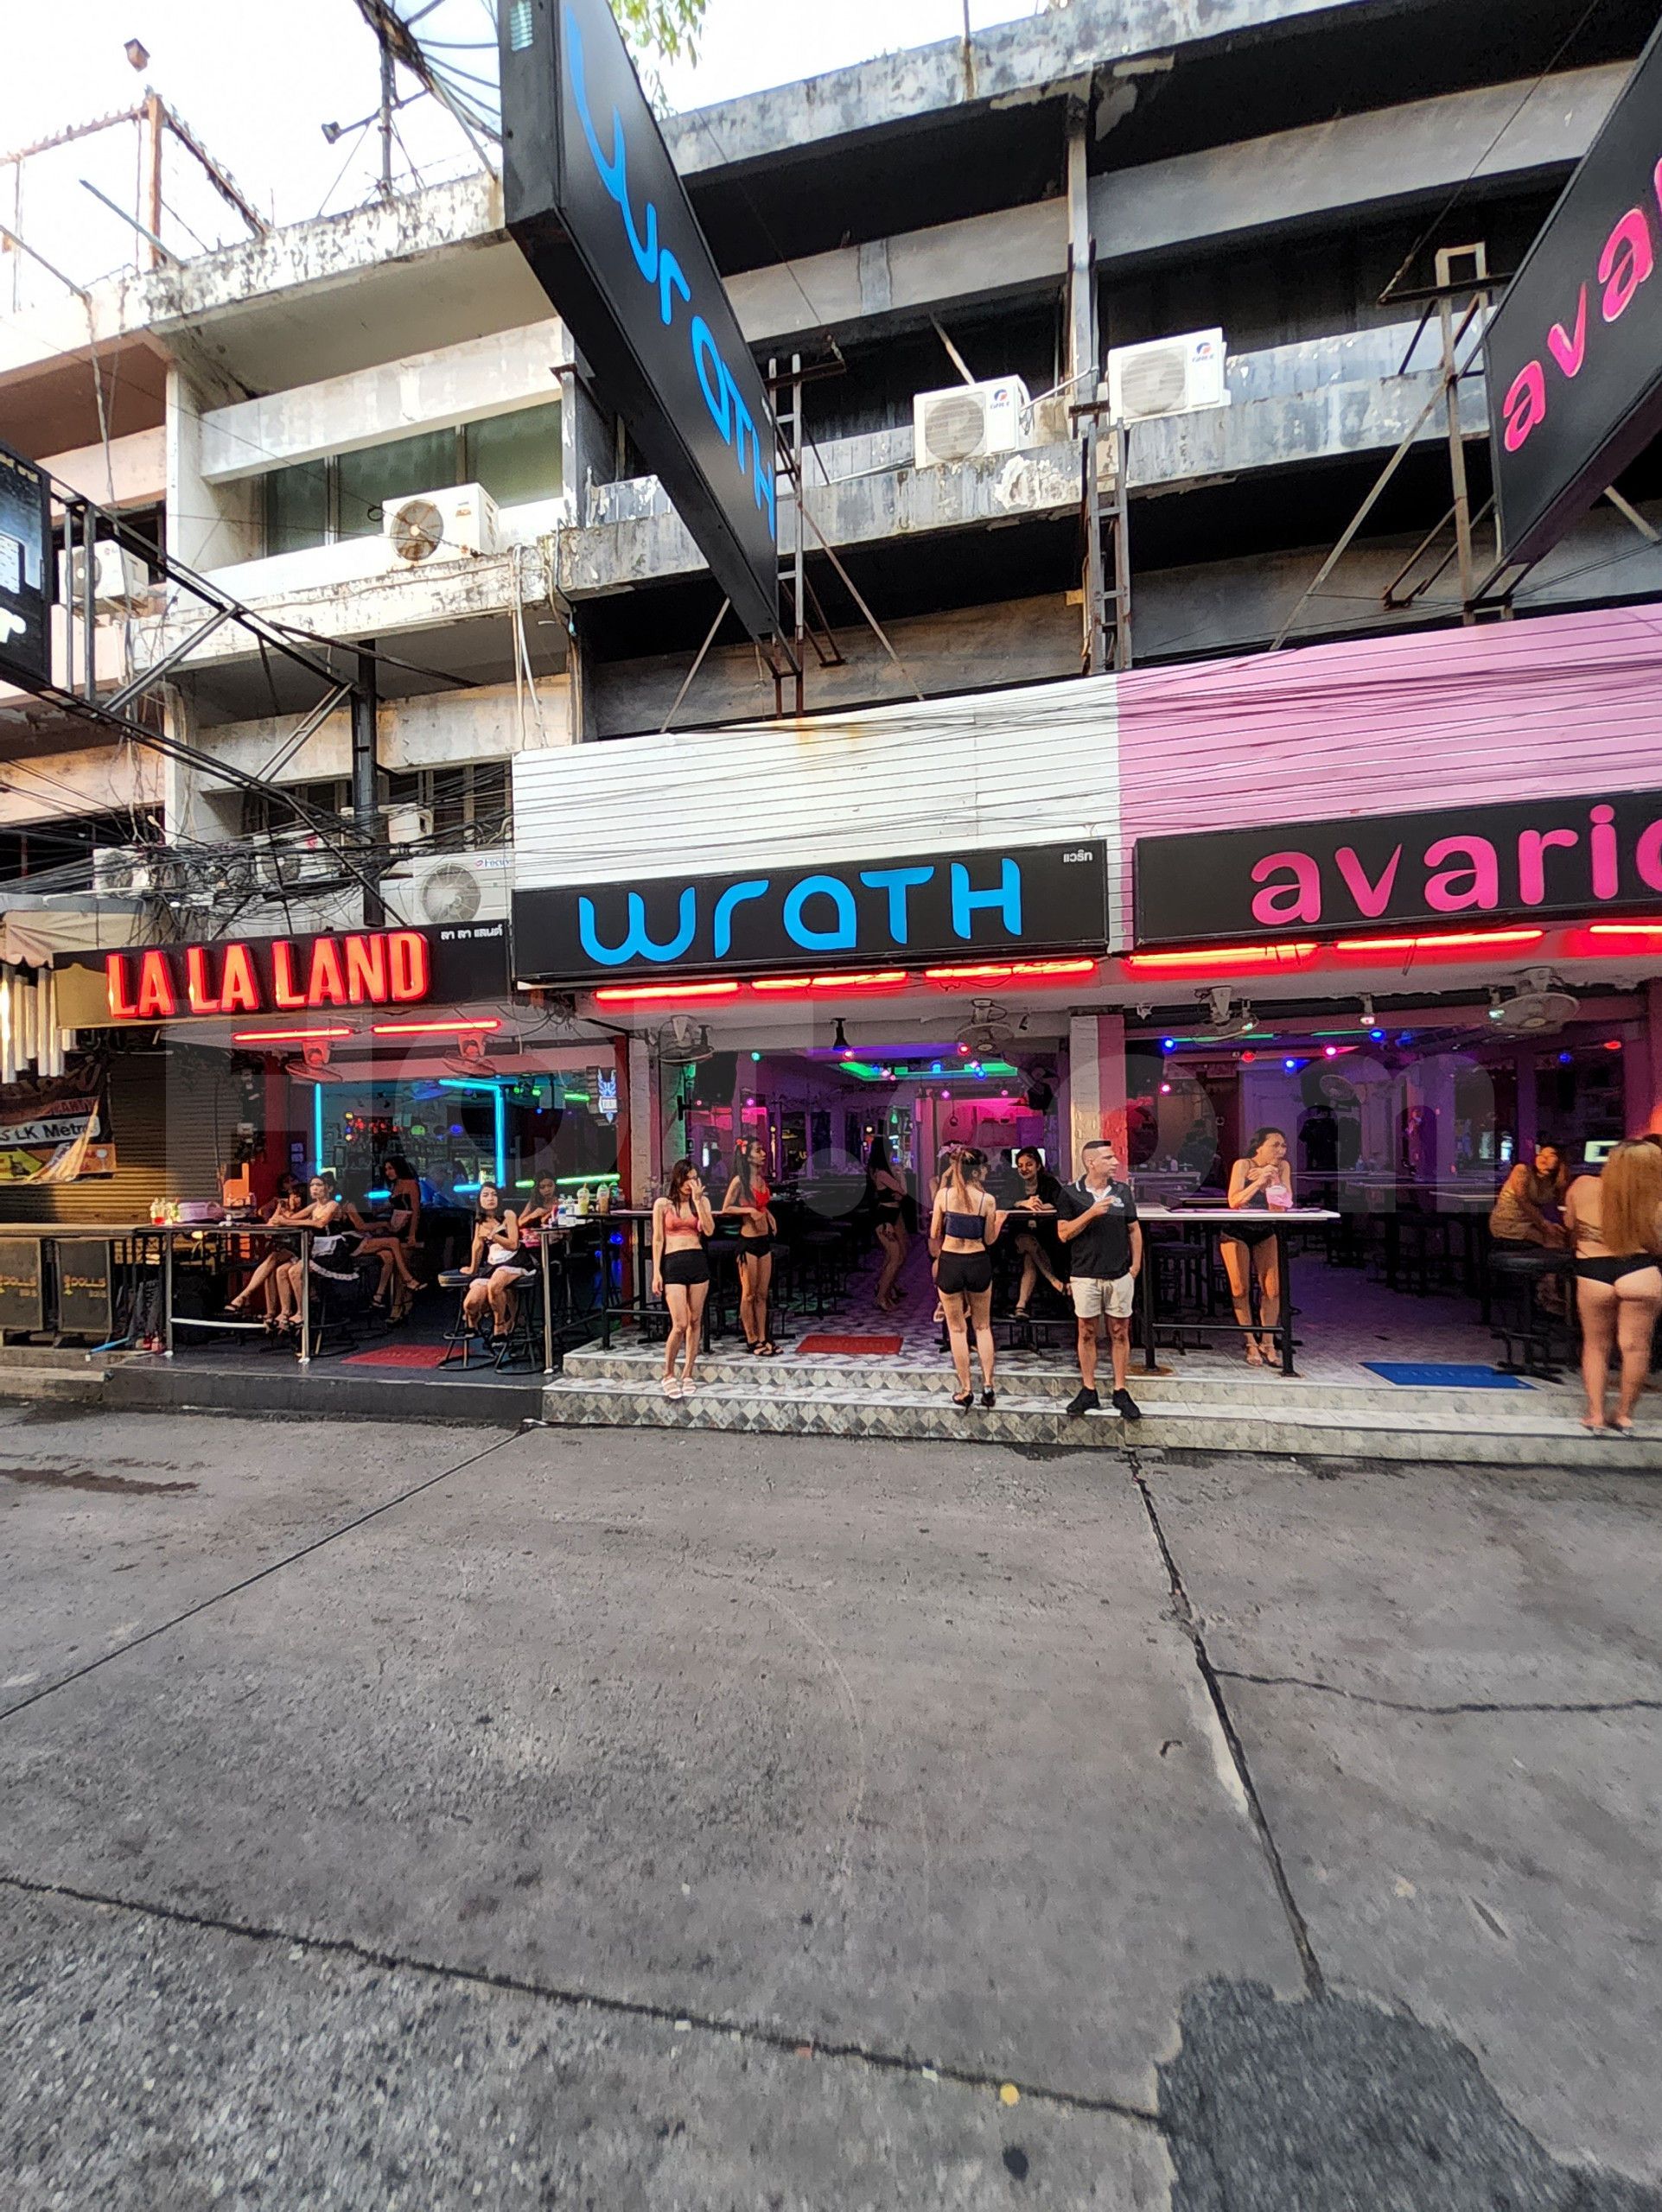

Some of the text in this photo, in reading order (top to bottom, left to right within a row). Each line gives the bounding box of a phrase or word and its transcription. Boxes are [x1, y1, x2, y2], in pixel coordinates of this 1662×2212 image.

[1502, 157, 1662, 453] ava
[105, 931, 429, 1020] LA LA LAND
[15, 1125, 39, 1141] LK
